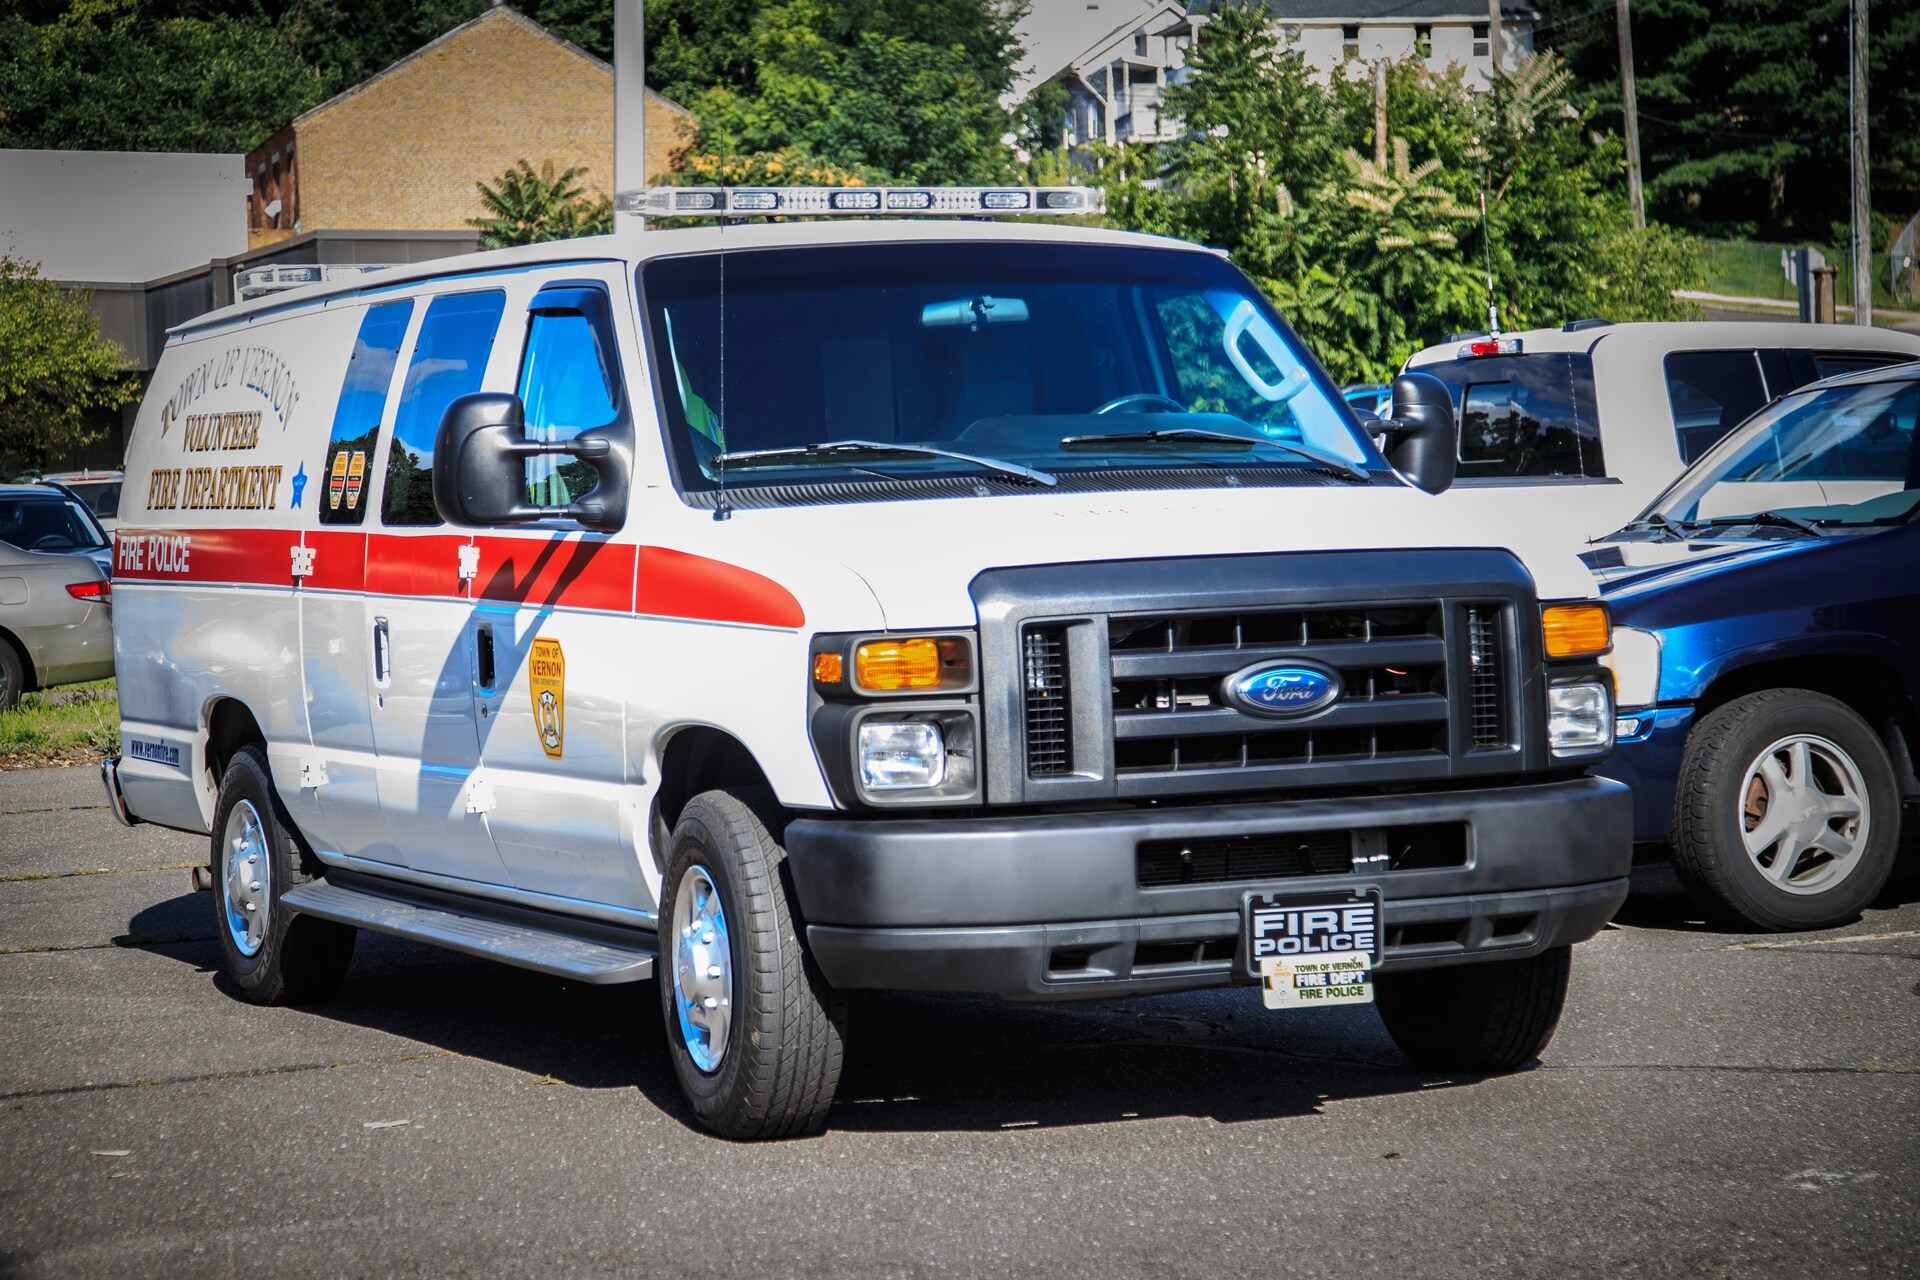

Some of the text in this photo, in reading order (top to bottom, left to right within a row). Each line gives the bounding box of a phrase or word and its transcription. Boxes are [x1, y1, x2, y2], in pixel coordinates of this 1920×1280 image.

[161, 344, 300, 439] TOWN OF VERNON
[183, 410, 263, 452] VOLUNTEER
[147, 465, 283, 510] FIRE DEPARTMENT
[118, 535, 191, 573] FIRE POLICE
[535, 646, 559, 659] TOWN OF
[532, 660, 562, 678] VERNON
[1263, 676, 1315, 702] Ford
[1254, 908, 1375, 938] FIRE
[1255, 932, 1375, 956] POLICE
[1295, 964, 1318, 973] TOWN
[1320, 963, 1331, 971] OF
[1332, 961, 1364, 970] VERNON
[1296, 972, 1327, 987] FIRE
[1329, 970, 1365, 985] DEPT
[1300, 986, 1364, 1000] FIRE POLICE
